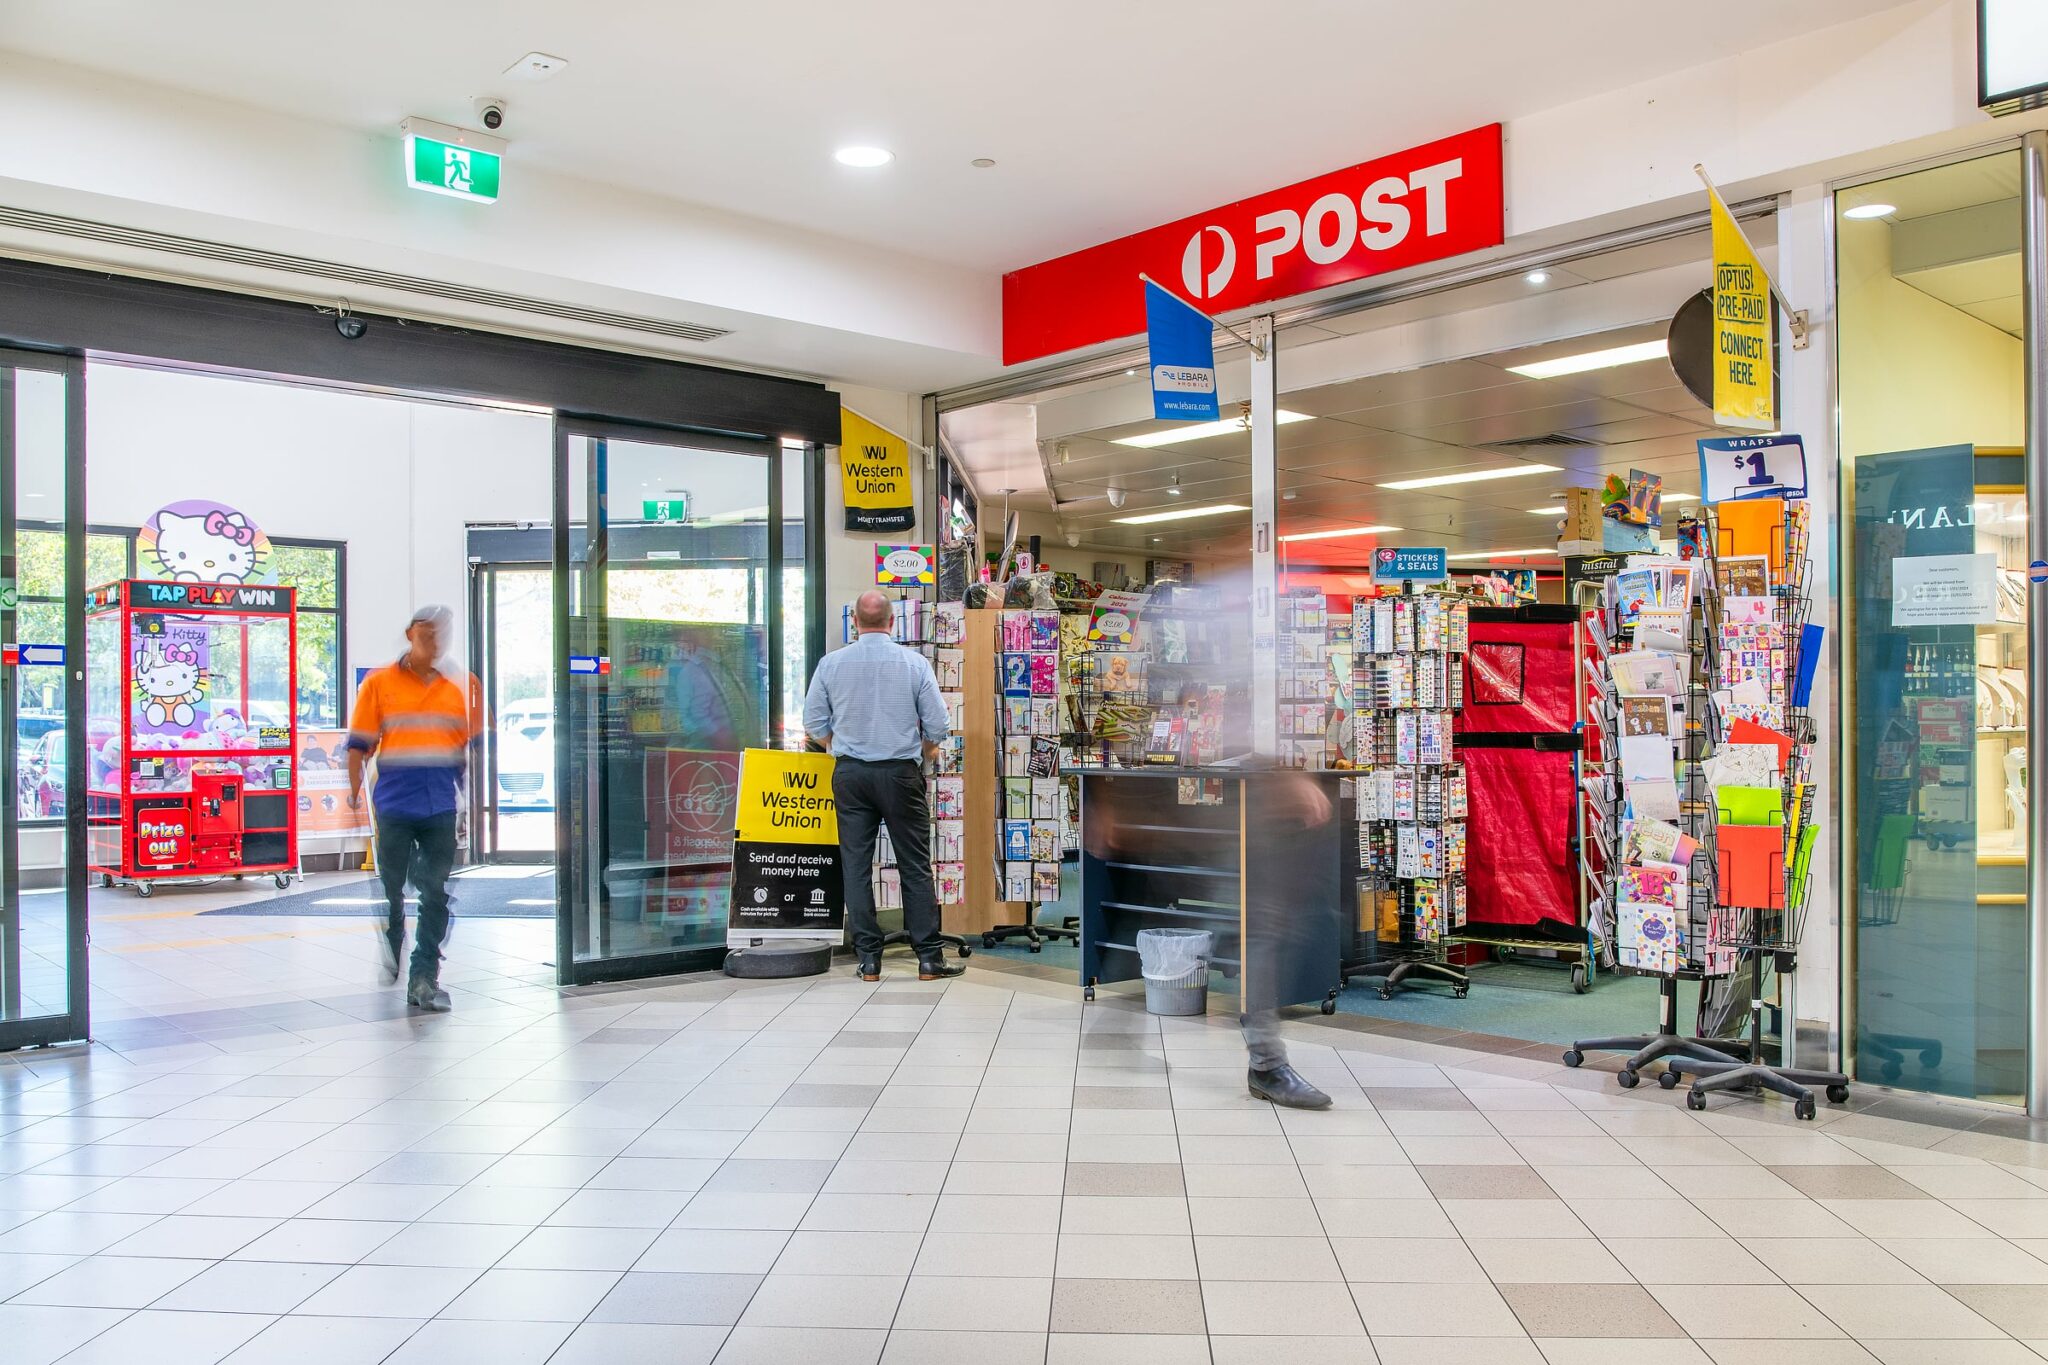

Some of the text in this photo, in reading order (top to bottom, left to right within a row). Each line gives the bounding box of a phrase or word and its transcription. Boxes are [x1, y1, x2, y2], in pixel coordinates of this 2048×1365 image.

[1255, 157, 1463, 281] POST
[1718, 267, 1751, 292] OPTUS
[1718, 294, 1764, 320] PRE-PAID
[1720, 330, 1763, 361] CONNECT
[1177, 371, 1209, 382] LEBARA
[1729, 360, 1757, 386] HERE.
[1164, 401, 1211, 411] www.lebara.com
[1727, 438, 1773, 448] WRAPS
[861, 445, 887, 461] WU
[845, 463, 903, 478] Western
[1733, 451, 1774, 485] $1
[856, 479, 896, 494] Union
[875, 515, 905, 523] TRANSFER
[892, 559, 919, 568] $2.00
[1397, 554, 1439, 562] STICKERS
[1581, 559, 1618, 571] mistral
[1397, 562, 1438, 571] & SEALS
[148, 585, 276, 606] TAP PLAY WIN
[172, 625, 207, 645] Kitty
[1623, 700, 1666, 714] Husband
[783, 771, 818, 790] WU
[761, 791, 835, 811] Western
[771, 811, 822, 829] Union
[140, 822, 185, 839] Prize
[148, 839, 178, 855] out
[749, 852, 833, 865] Send and receive
[761, 865, 820, 878] money here
[1639, 871, 1664, 896] 18
[784, 892, 796, 902] or
